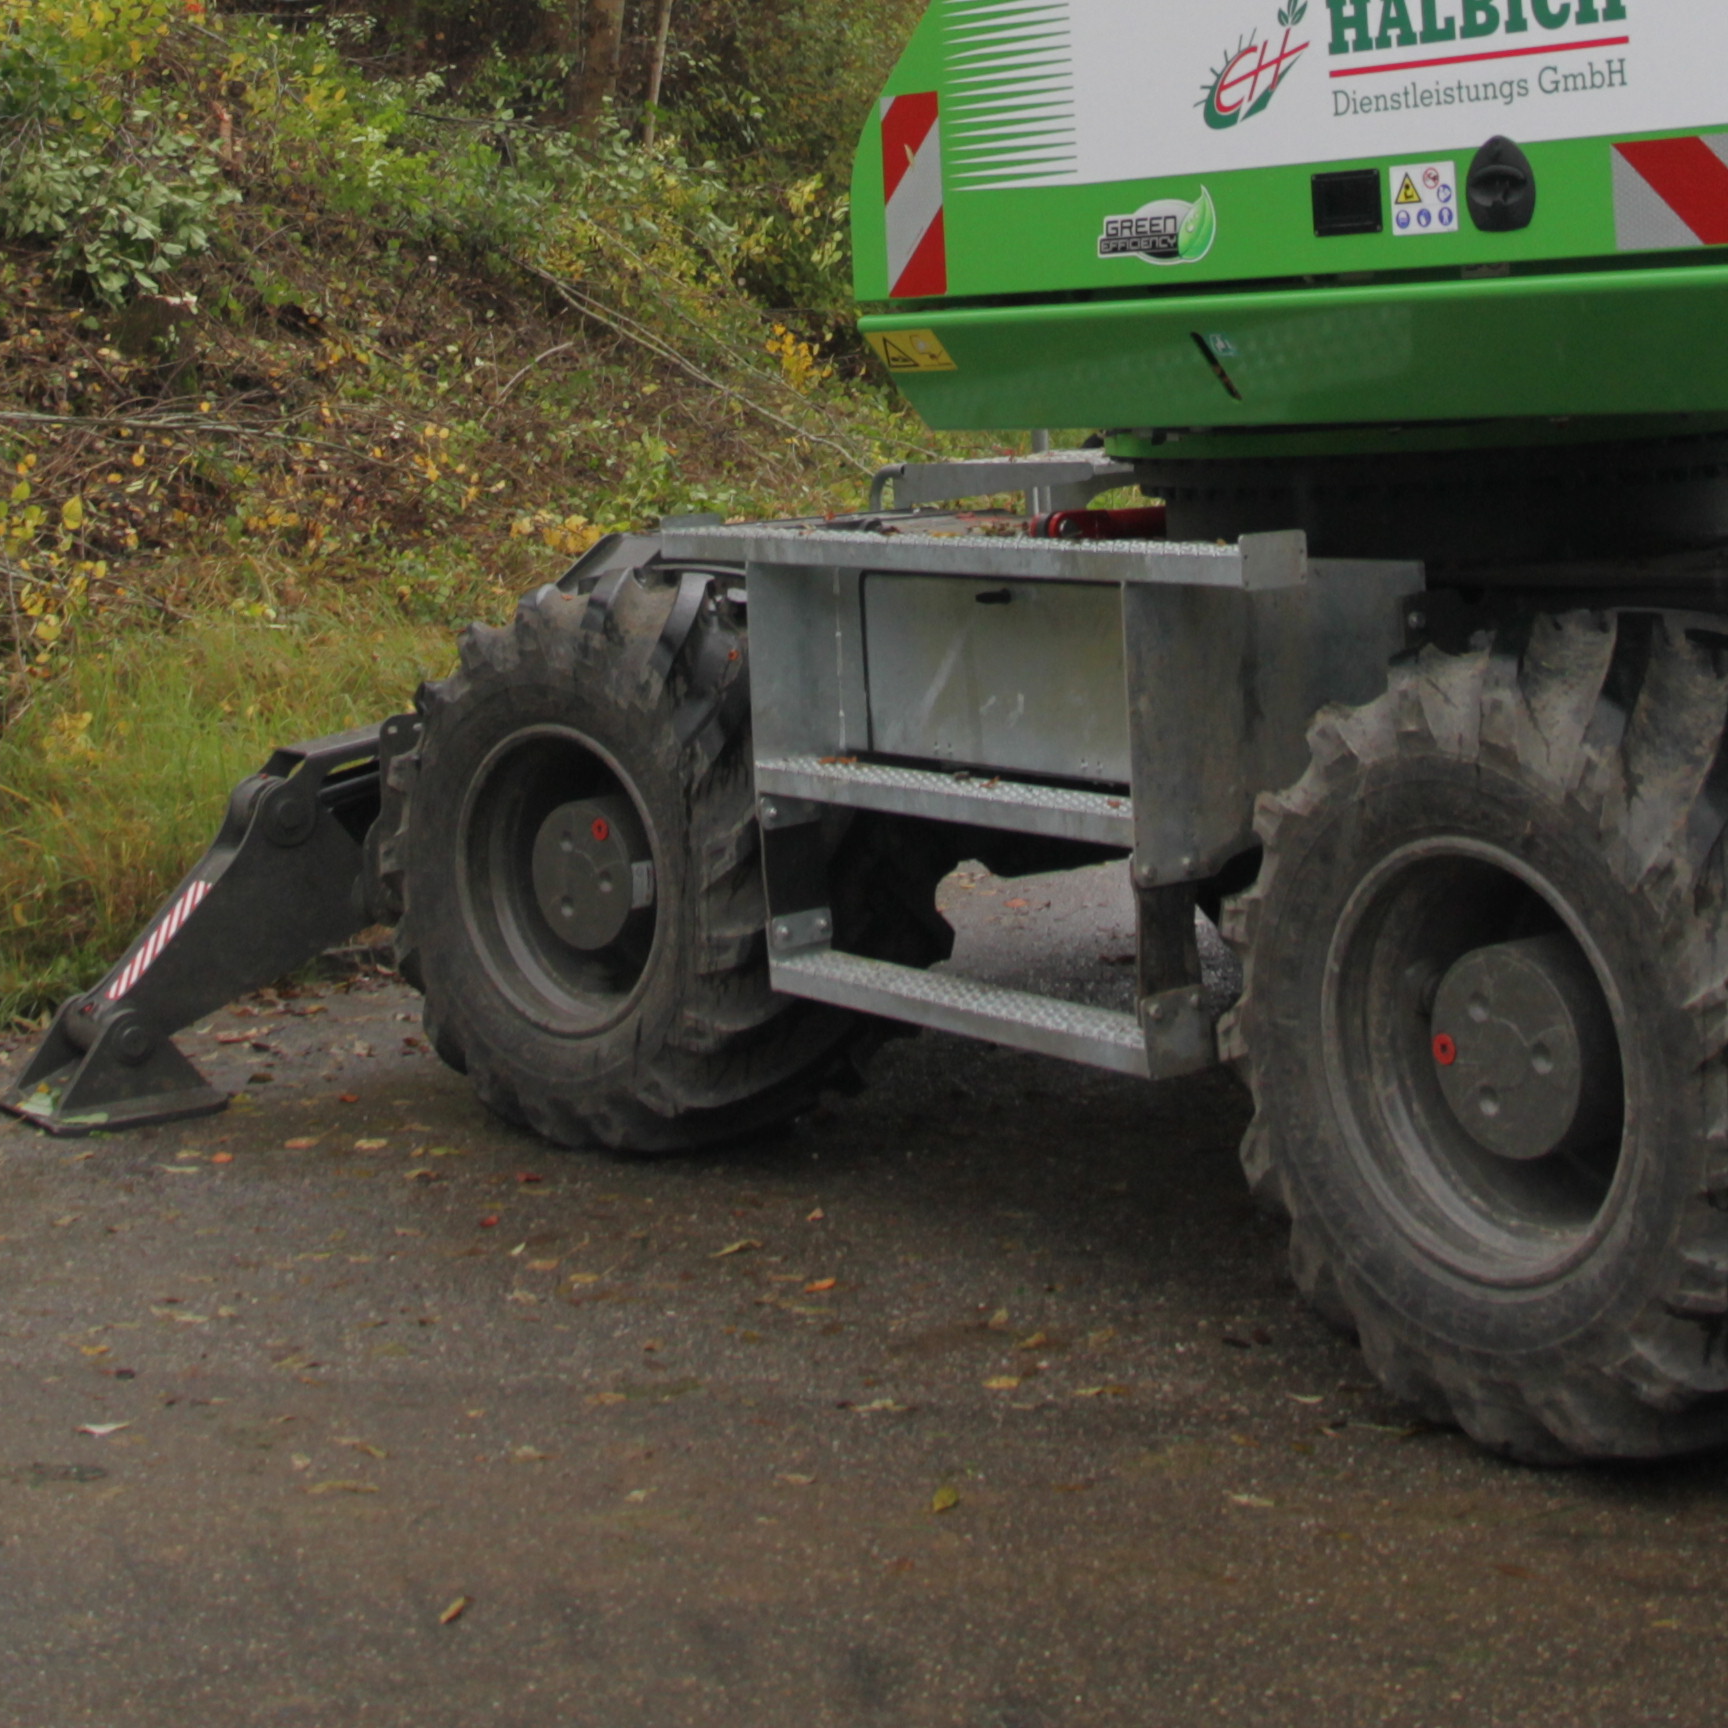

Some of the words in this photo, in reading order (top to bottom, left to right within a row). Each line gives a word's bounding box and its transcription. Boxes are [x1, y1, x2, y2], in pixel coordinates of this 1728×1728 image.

[1332, 75, 1530, 117] Dienstleistungs
[1537, 59, 1629, 95] GmbH
[1105, 215, 1177, 238] GREEN
[1100, 235, 1177, 253] EFFICIENCY
